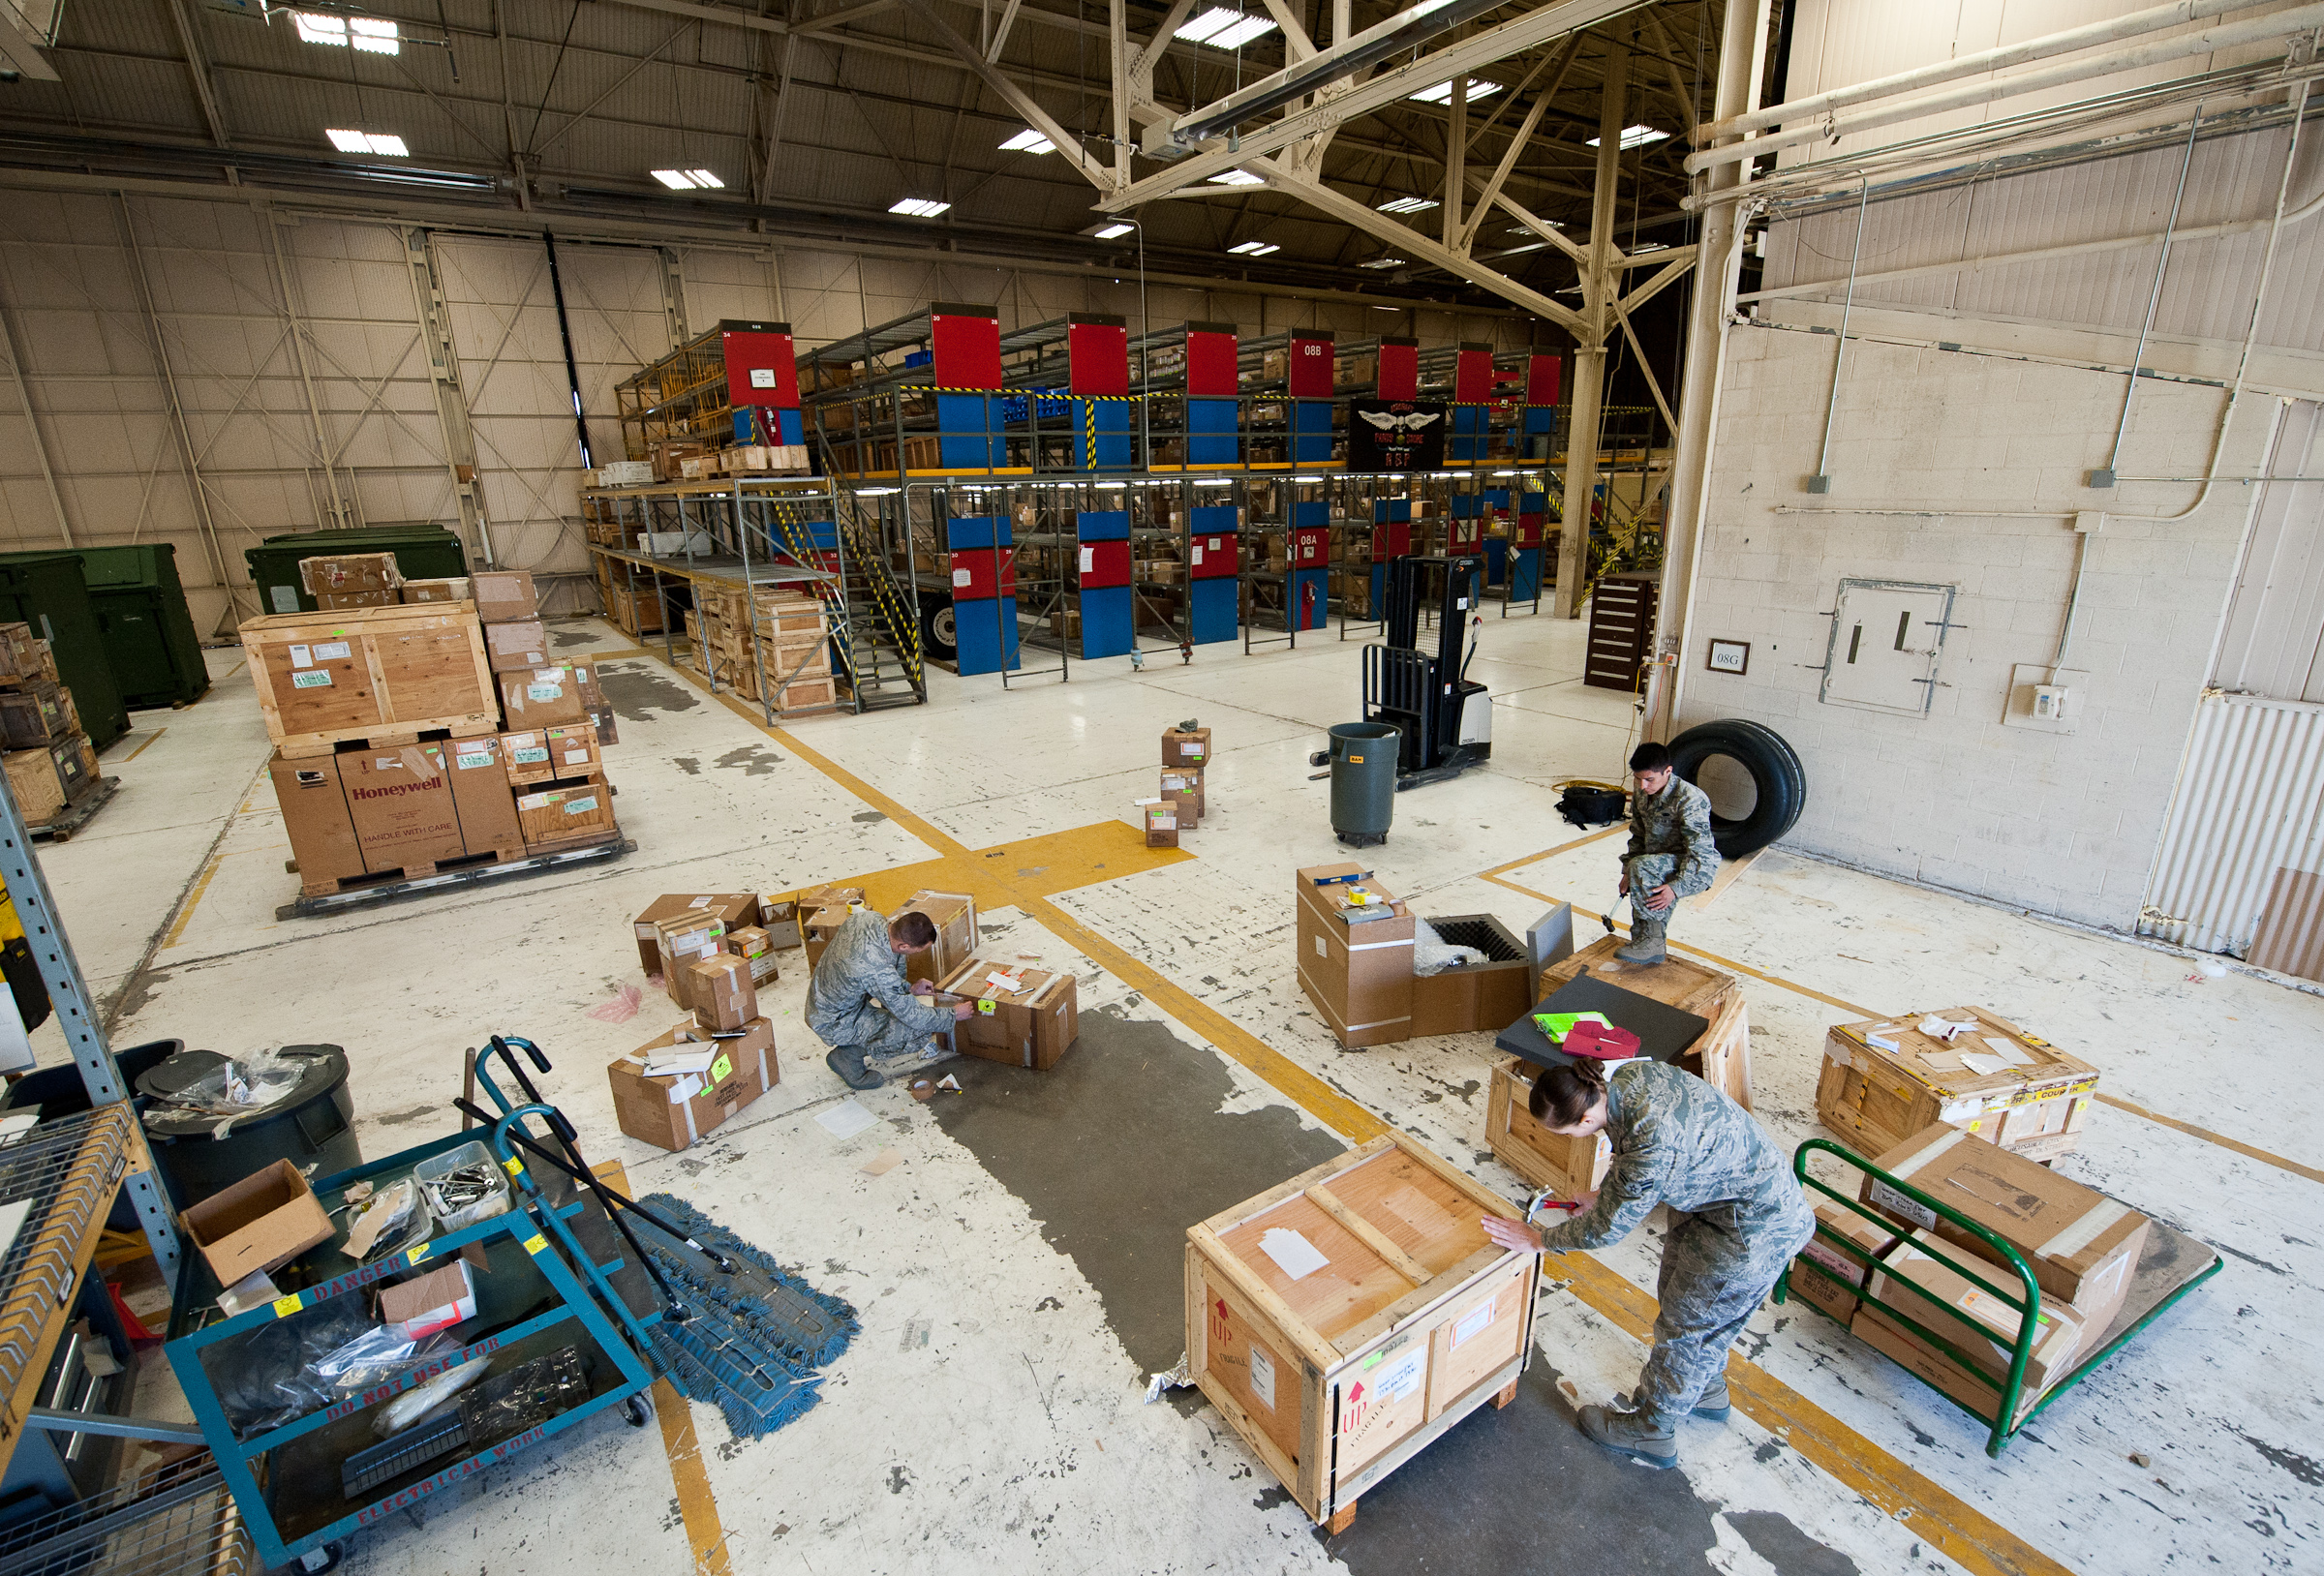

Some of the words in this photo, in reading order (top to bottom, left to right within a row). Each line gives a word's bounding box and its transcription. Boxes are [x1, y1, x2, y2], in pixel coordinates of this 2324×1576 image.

[1304, 345, 1322, 356] 08B
[1300, 534, 1317, 545] 08A
[1717, 652, 1739, 665] 08G
[352, 776, 443, 801] Honeywell
[364, 831, 402, 843] HANDLE
[403, 827, 426, 836] WITH
[428, 822, 453, 833] CARE
[313, 1257, 402, 1301] DANGER
[1213, 1315, 1232, 1348] UP
[326, 1397, 353, 1422] DO
[363, 1379, 403, 1405] NOT
[414, 1360, 453, 1383] USE
[462, 1337, 500, 1362] FOR
[1343, 1401, 1367, 1433] UP
[357, 1458, 484, 1524] ELECTRICAL
[493, 1427, 546, 1457] WORK
